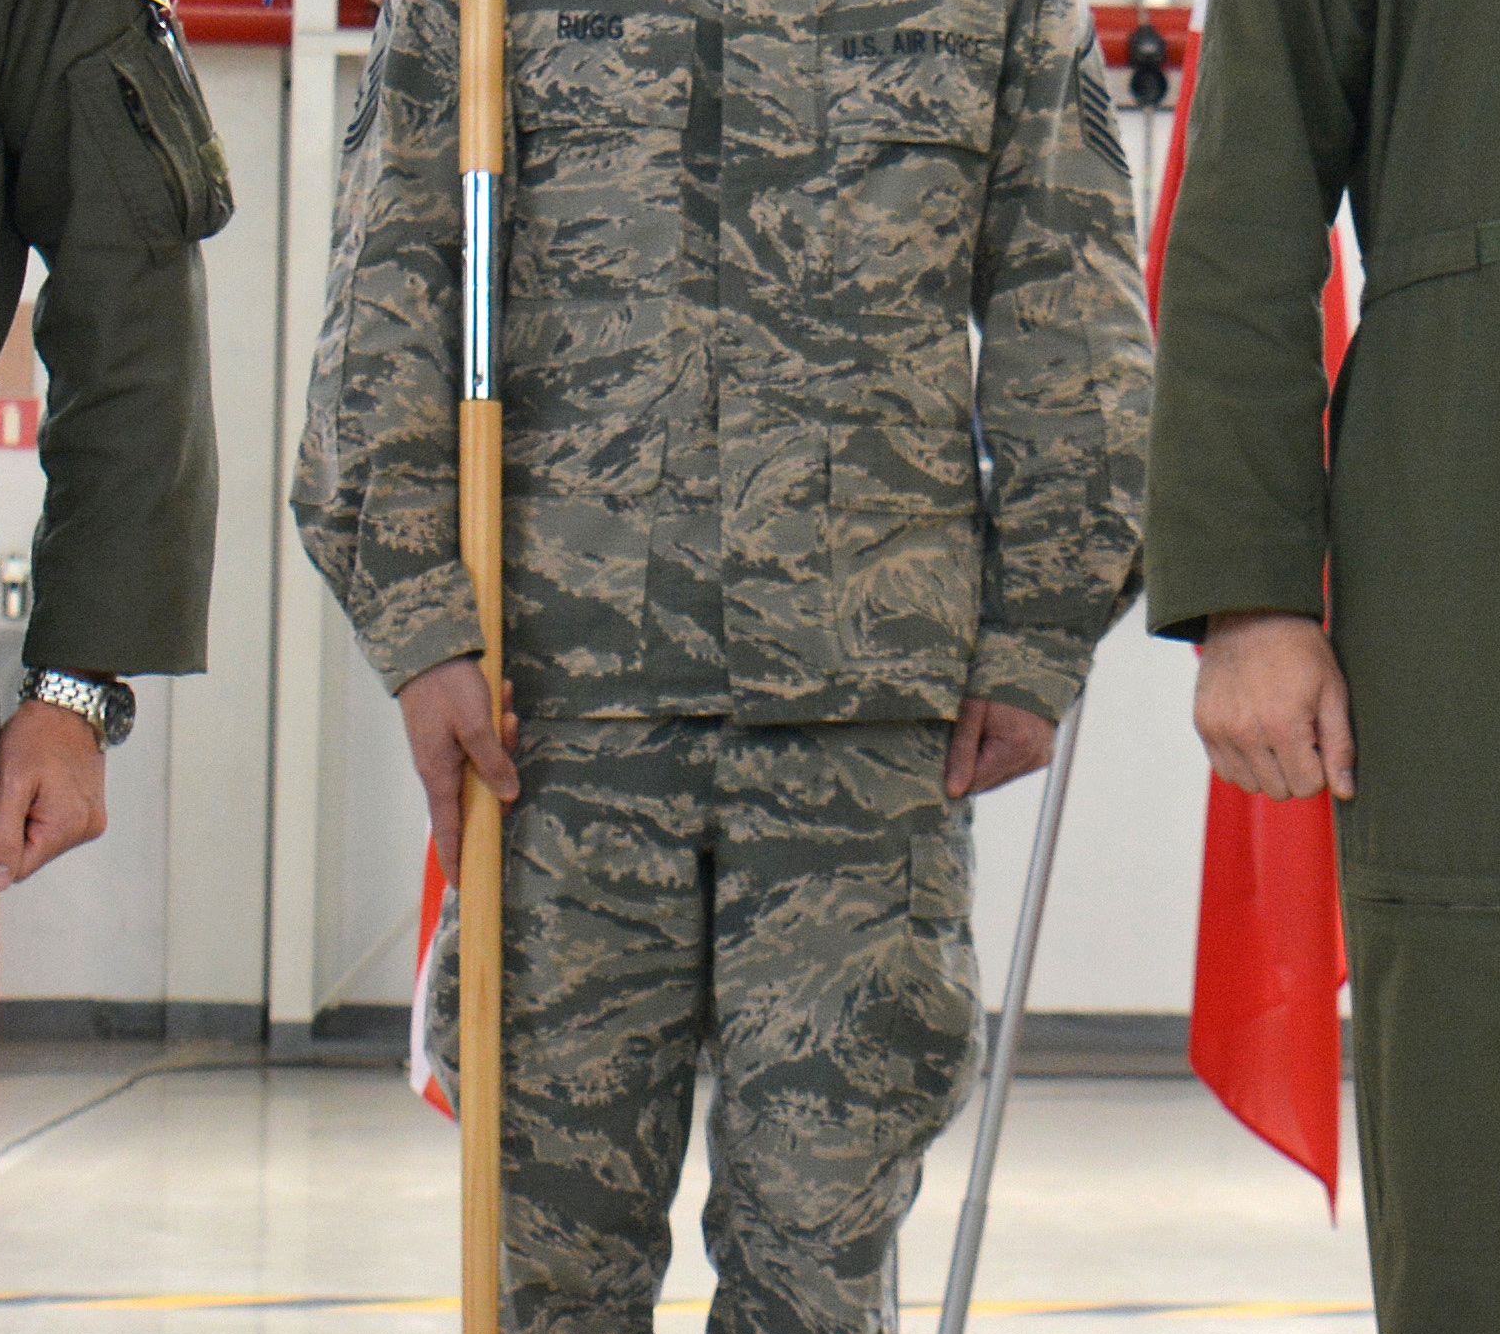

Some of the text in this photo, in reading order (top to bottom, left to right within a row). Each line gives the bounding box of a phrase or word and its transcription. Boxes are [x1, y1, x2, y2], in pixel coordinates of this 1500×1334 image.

[557, 11, 624, 40] RUGG
[842, 34, 885, 61] U.S.
[893, 29, 927, 55] AIR
